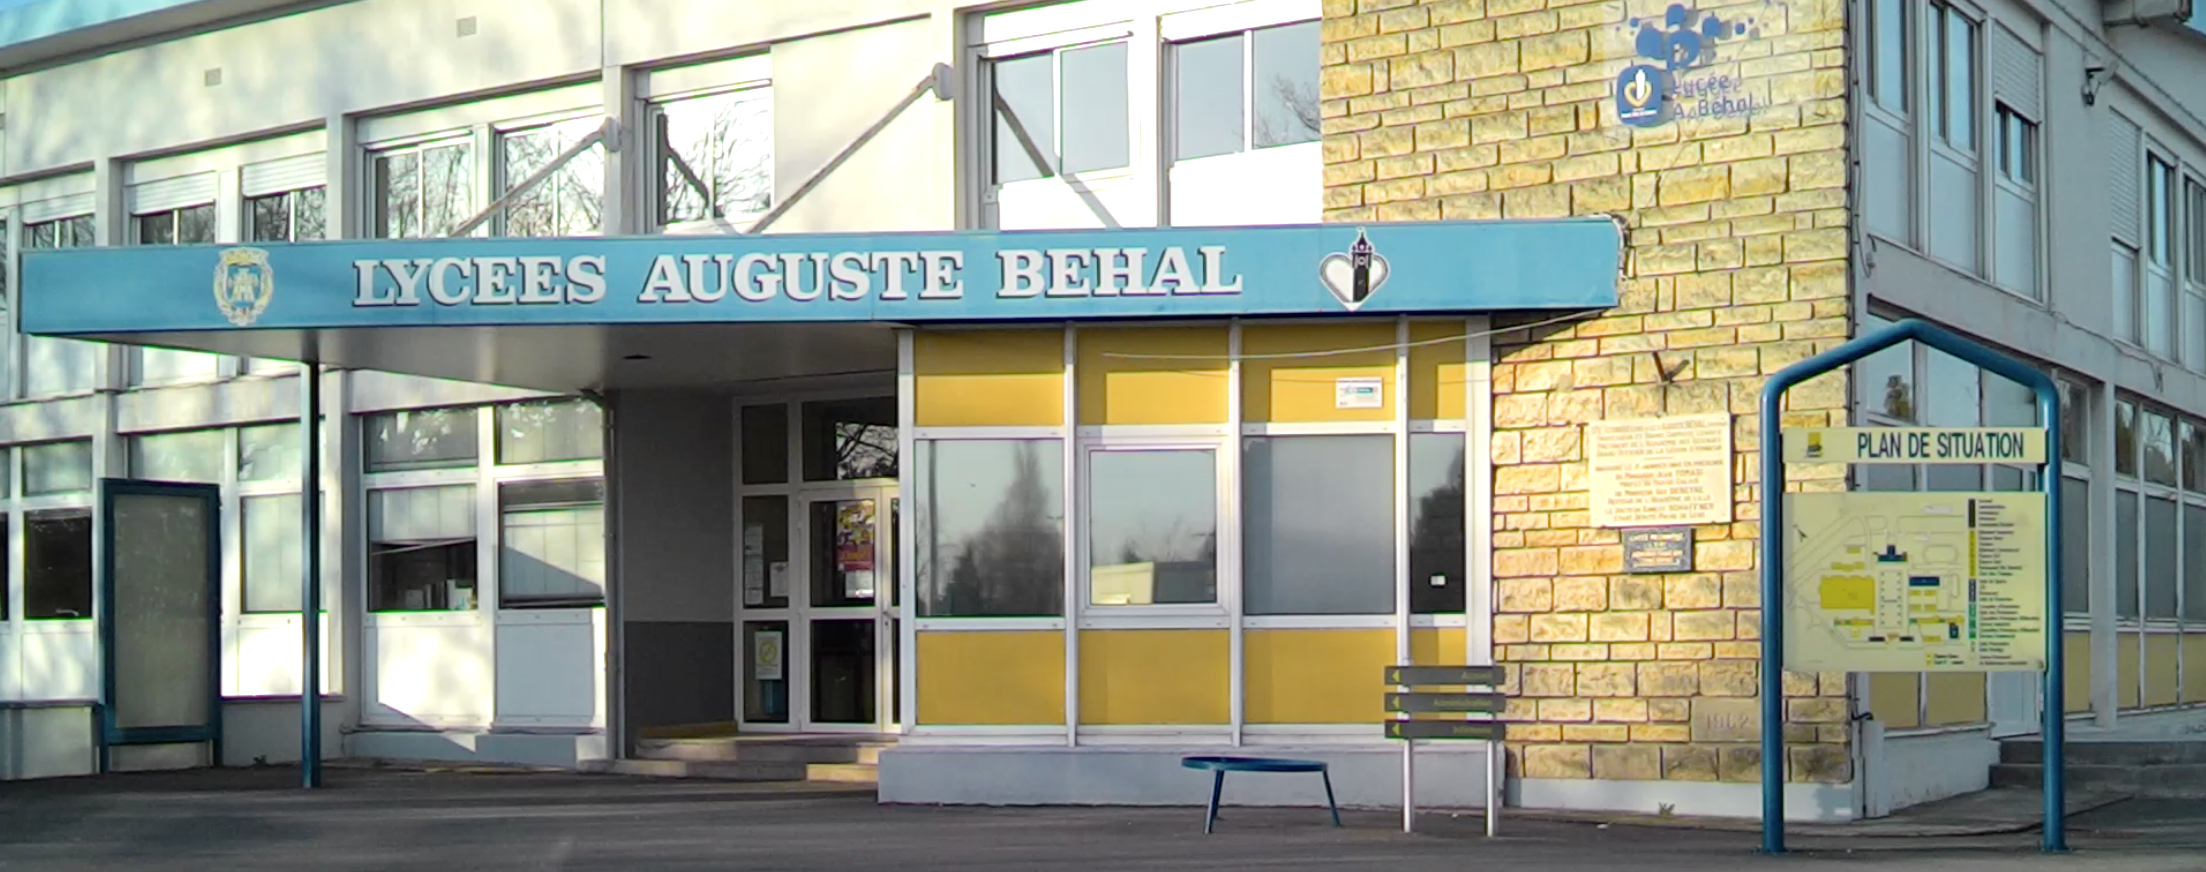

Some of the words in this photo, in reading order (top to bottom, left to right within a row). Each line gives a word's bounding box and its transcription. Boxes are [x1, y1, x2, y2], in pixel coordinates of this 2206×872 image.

[352, 254, 607, 308] LYCEES
[637, 251, 964, 304] AUGUSTE
[996, 246, 1243, 299] BEHAL
[1857, 432, 1901, 458] PLAN
[1908, 432, 1931, 458] DE
[1937, 432, 2024, 458] SITUATION
